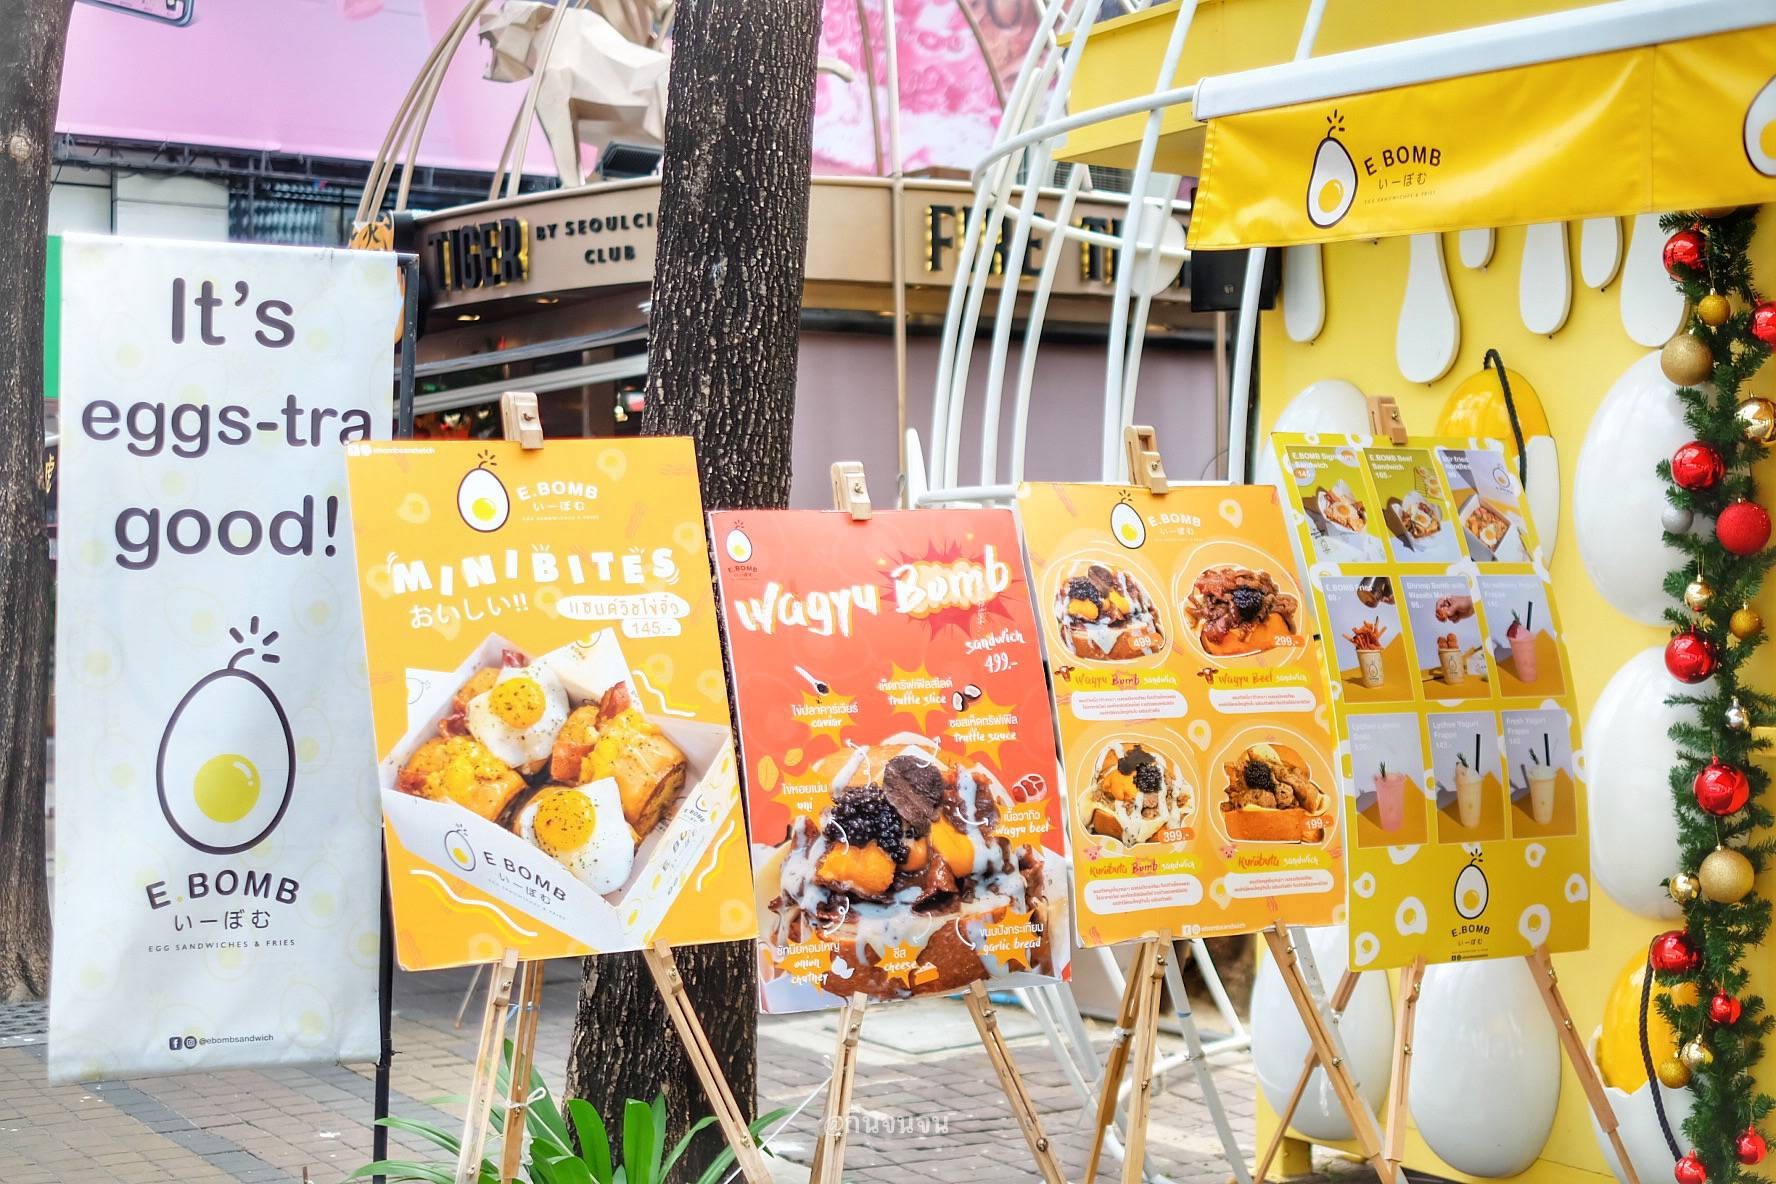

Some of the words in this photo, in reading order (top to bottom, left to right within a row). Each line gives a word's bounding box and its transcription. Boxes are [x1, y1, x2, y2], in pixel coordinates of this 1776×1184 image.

[536, 223, 557, 241] BY
[565, 212, 653, 236] SEOULCI
[428, 217, 538, 292] TIGER
[584, 245, 636, 265] CLUB
[81, 394, 372, 459] eggs-tra
[516, 480, 598, 501] E.BOMB
[115, 494, 339, 570] good!
[392, 549, 519, 596] MINI
[531, 547, 677, 585] BITES
[734, 580, 880, 638] Wagyu
[891, 543, 1010, 614] Bomb
[965, 627, 1026, 655] sandwich
[984, 651, 1019, 673] 499.-
[145, 869, 300, 910] E.BOMB
[174, 909, 271, 932] いーぼむ
[1451, 924, 1490, 937] E.BOMB
[175, 941, 249, 951] SANDWICHES
[266, 939, 296, 947] FRIES
[982, 938, 1010, 955] garlic
[1013, 936, 1042, 950] bread
[883, 960, 917, 972] cheese
[199, 1034, 274, 1046] @ebombsandwich
